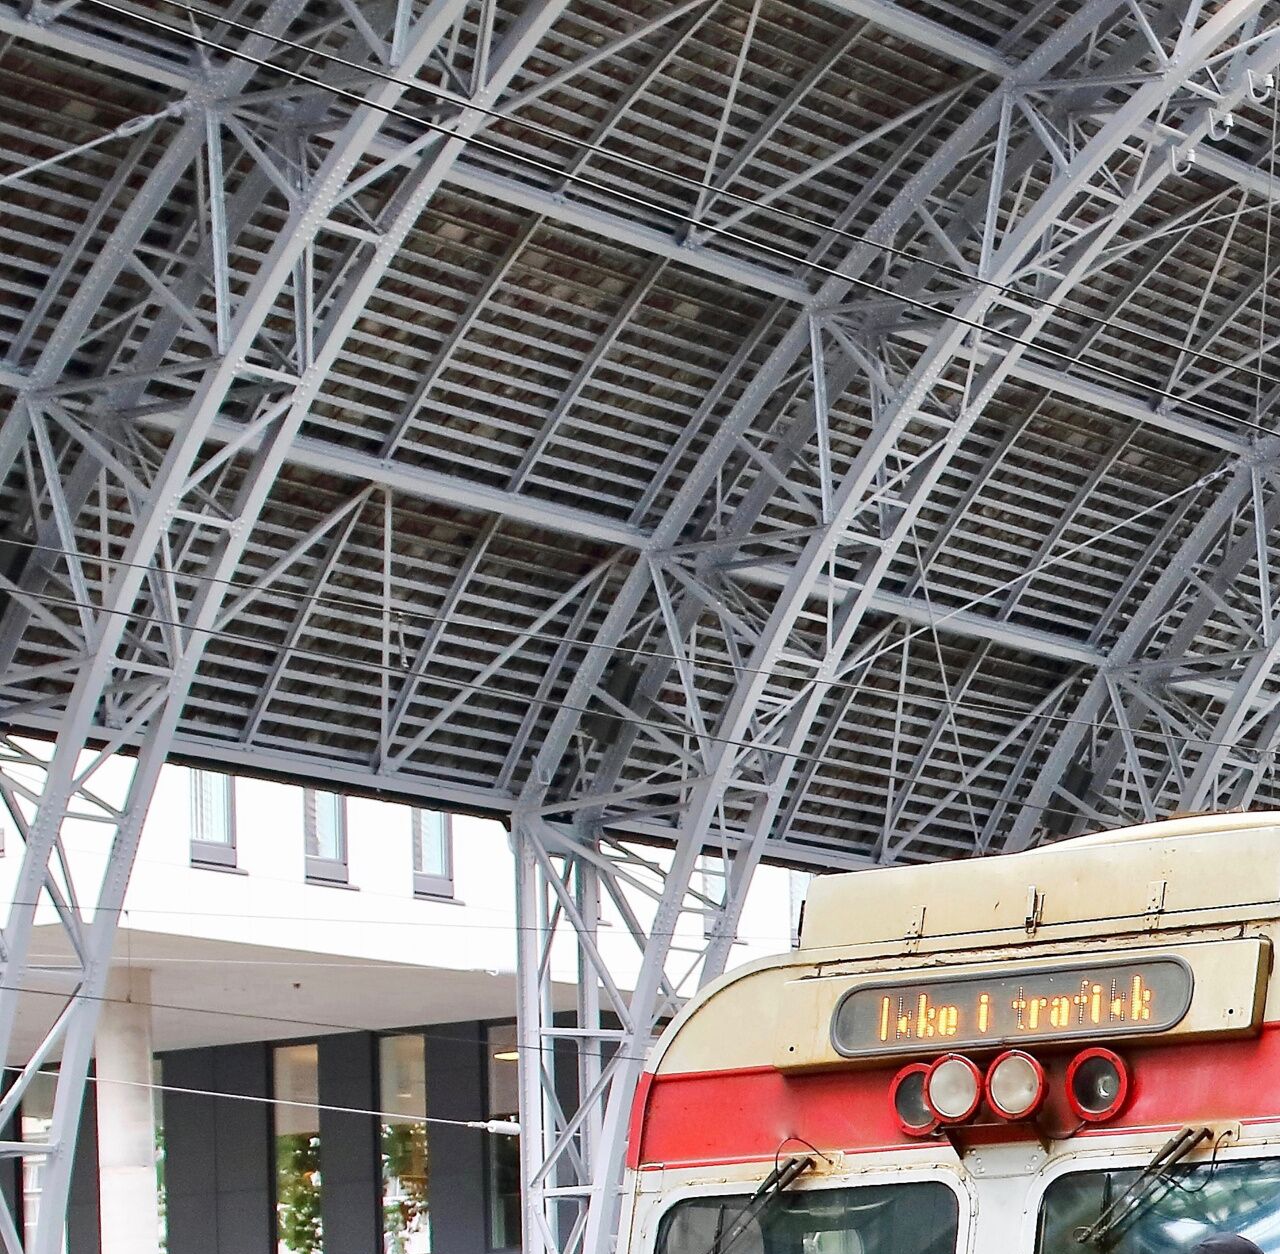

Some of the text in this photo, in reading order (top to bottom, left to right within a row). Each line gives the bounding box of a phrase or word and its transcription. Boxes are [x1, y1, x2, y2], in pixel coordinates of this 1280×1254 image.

[879, 975, 1152, 1042] Ikke i trafikk
